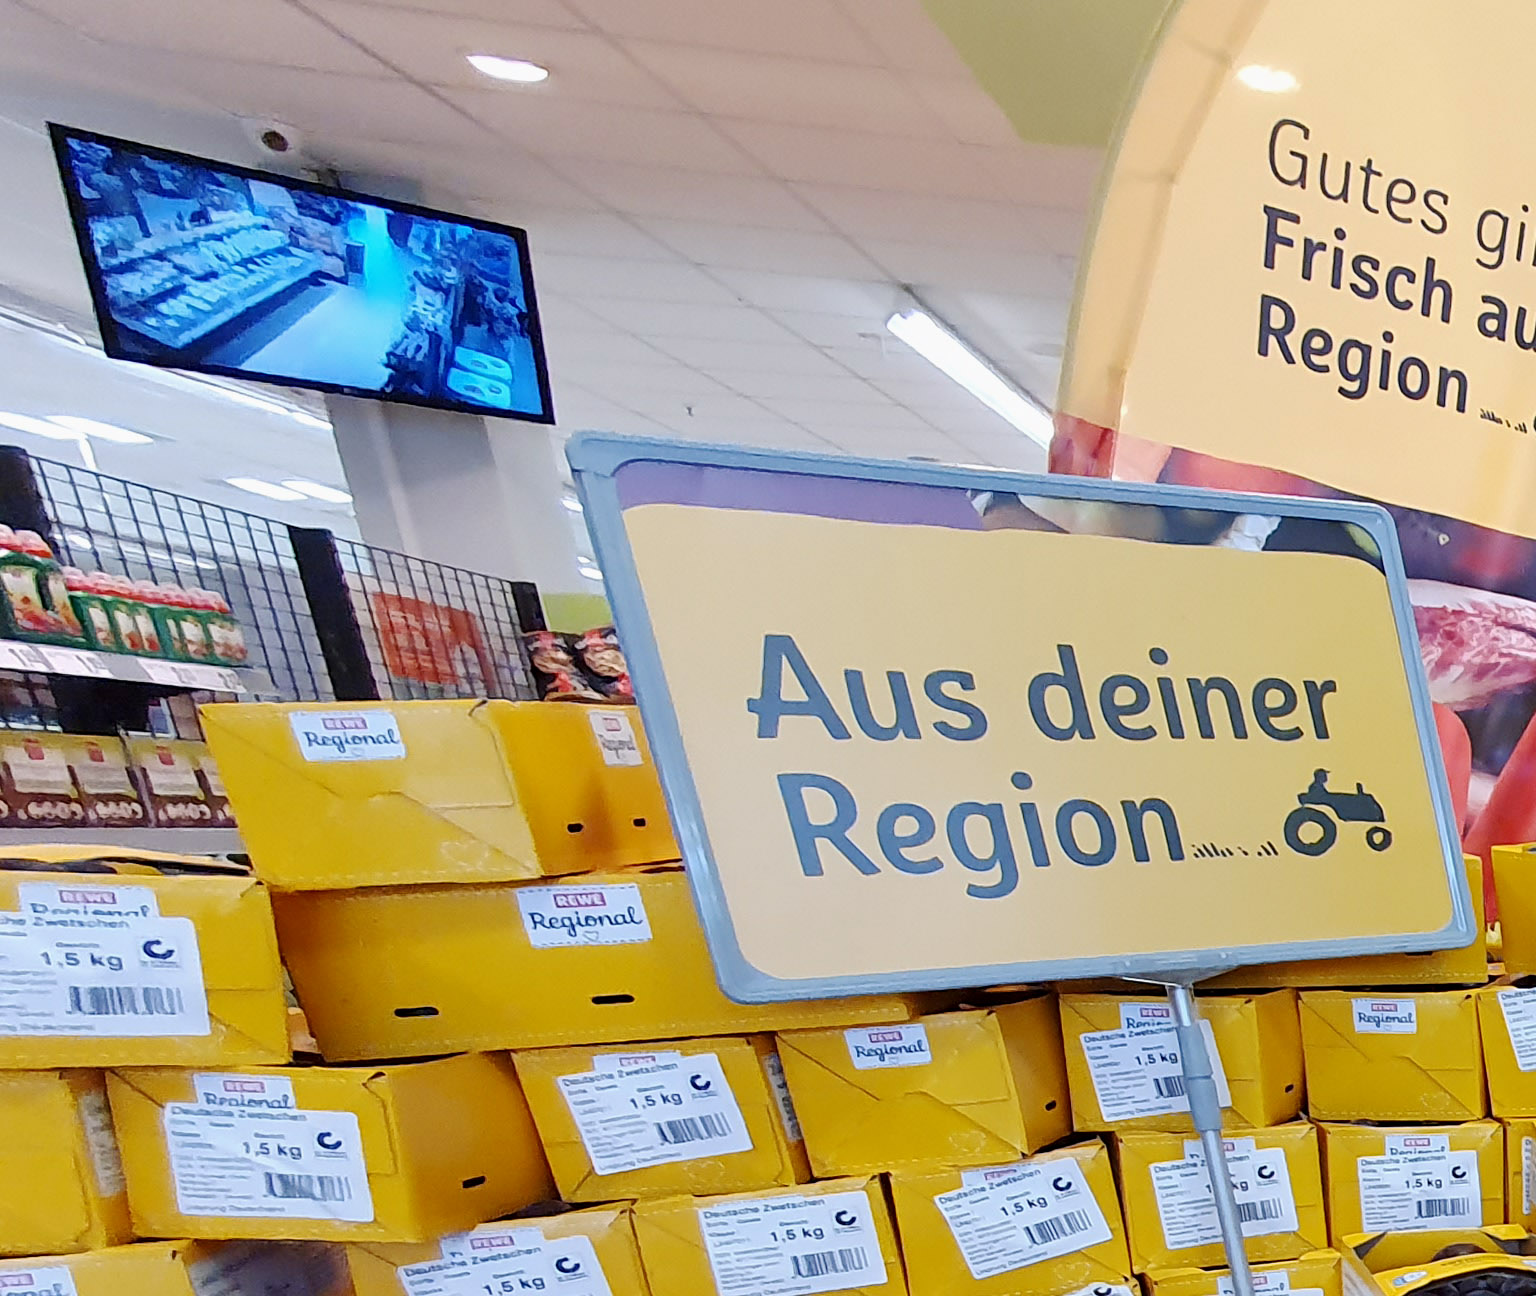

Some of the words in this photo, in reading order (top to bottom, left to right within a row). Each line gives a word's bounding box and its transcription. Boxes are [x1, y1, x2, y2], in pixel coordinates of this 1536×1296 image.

[1265, 116, 1452, 236] Gutes
[1263, 205, 1454, 324] Frisch
[1257, 294, 1470, 414] Region
[747, 634, 988, 744] Aus
[1027, 644, 1337, 743] deiner
[303, 729, 400, 754] Regional
[776, 771, 1186, 900] Region
[529, 907, 642, 937] Regional
[40, 951, 81, 968] 1,5
[90, 950, 123, 971] kg
[1358, 1011, 1415, 1028] Regional
[854, 1039, 926, 1059] Regional
[1136, 1053, 1157, 1067] 1,5
[1161, 1051, 1178, 1065] kg
[629, 1094, 657, 1110] 1,5
[660, 1091, 683, 1109] kg
[243, 1141, 270, 1157] 1,5
[277, 1140, 302, 1161] kg
[1405, 1178, 1423, 1190] 1,5
[1427, 1177, 1442, 1190] kg
[1000, 1201, 1025, 1217] 1,5
[1026, 1194, 1048, 1212] kg
[770, 1228, 797, 1244] 1,5
[801, 1226, 825, 1241] kg
[483, 1279, 514, 1296] 1,5
[519, 1273, 546, 1291] kg
